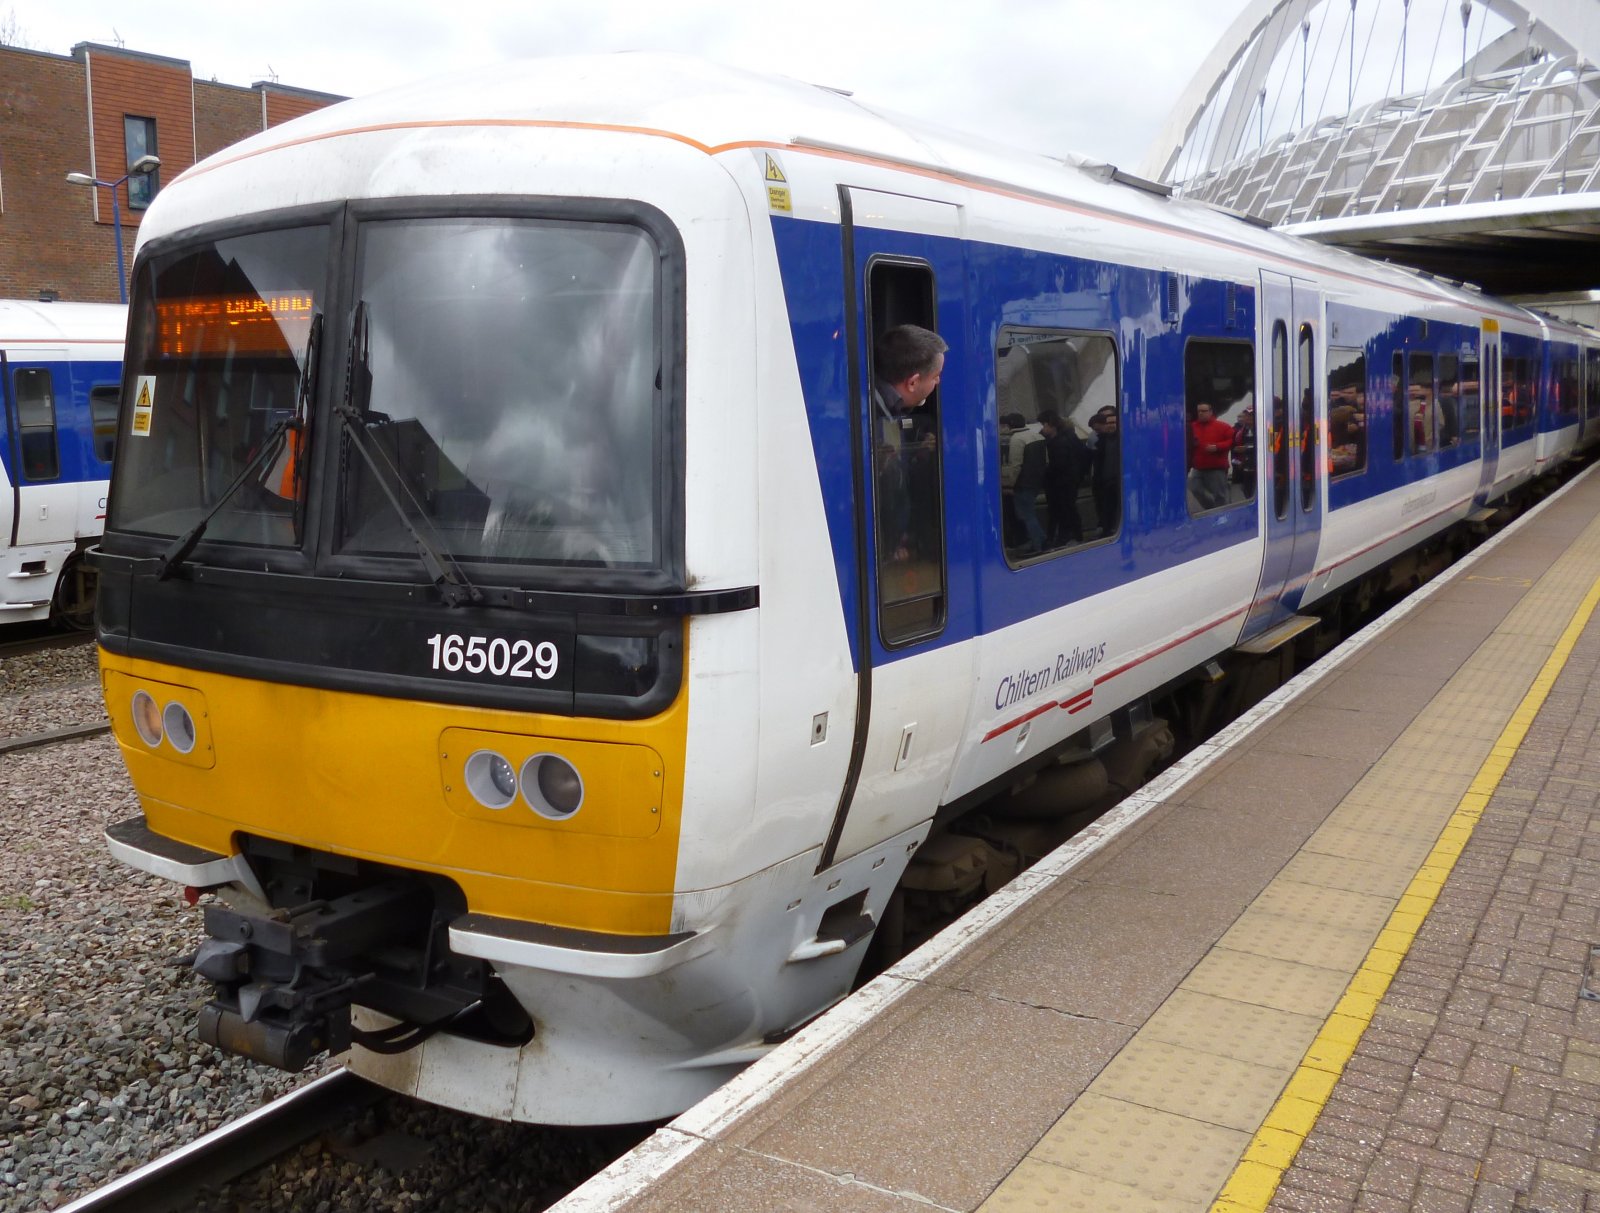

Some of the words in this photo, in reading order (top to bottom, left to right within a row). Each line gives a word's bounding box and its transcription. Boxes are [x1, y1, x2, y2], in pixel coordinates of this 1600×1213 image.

[427, 633, 559, 680] 165029
[995, 669, 1051, 710] Chiltern
[1052, 642, 1106, 684] Railways
